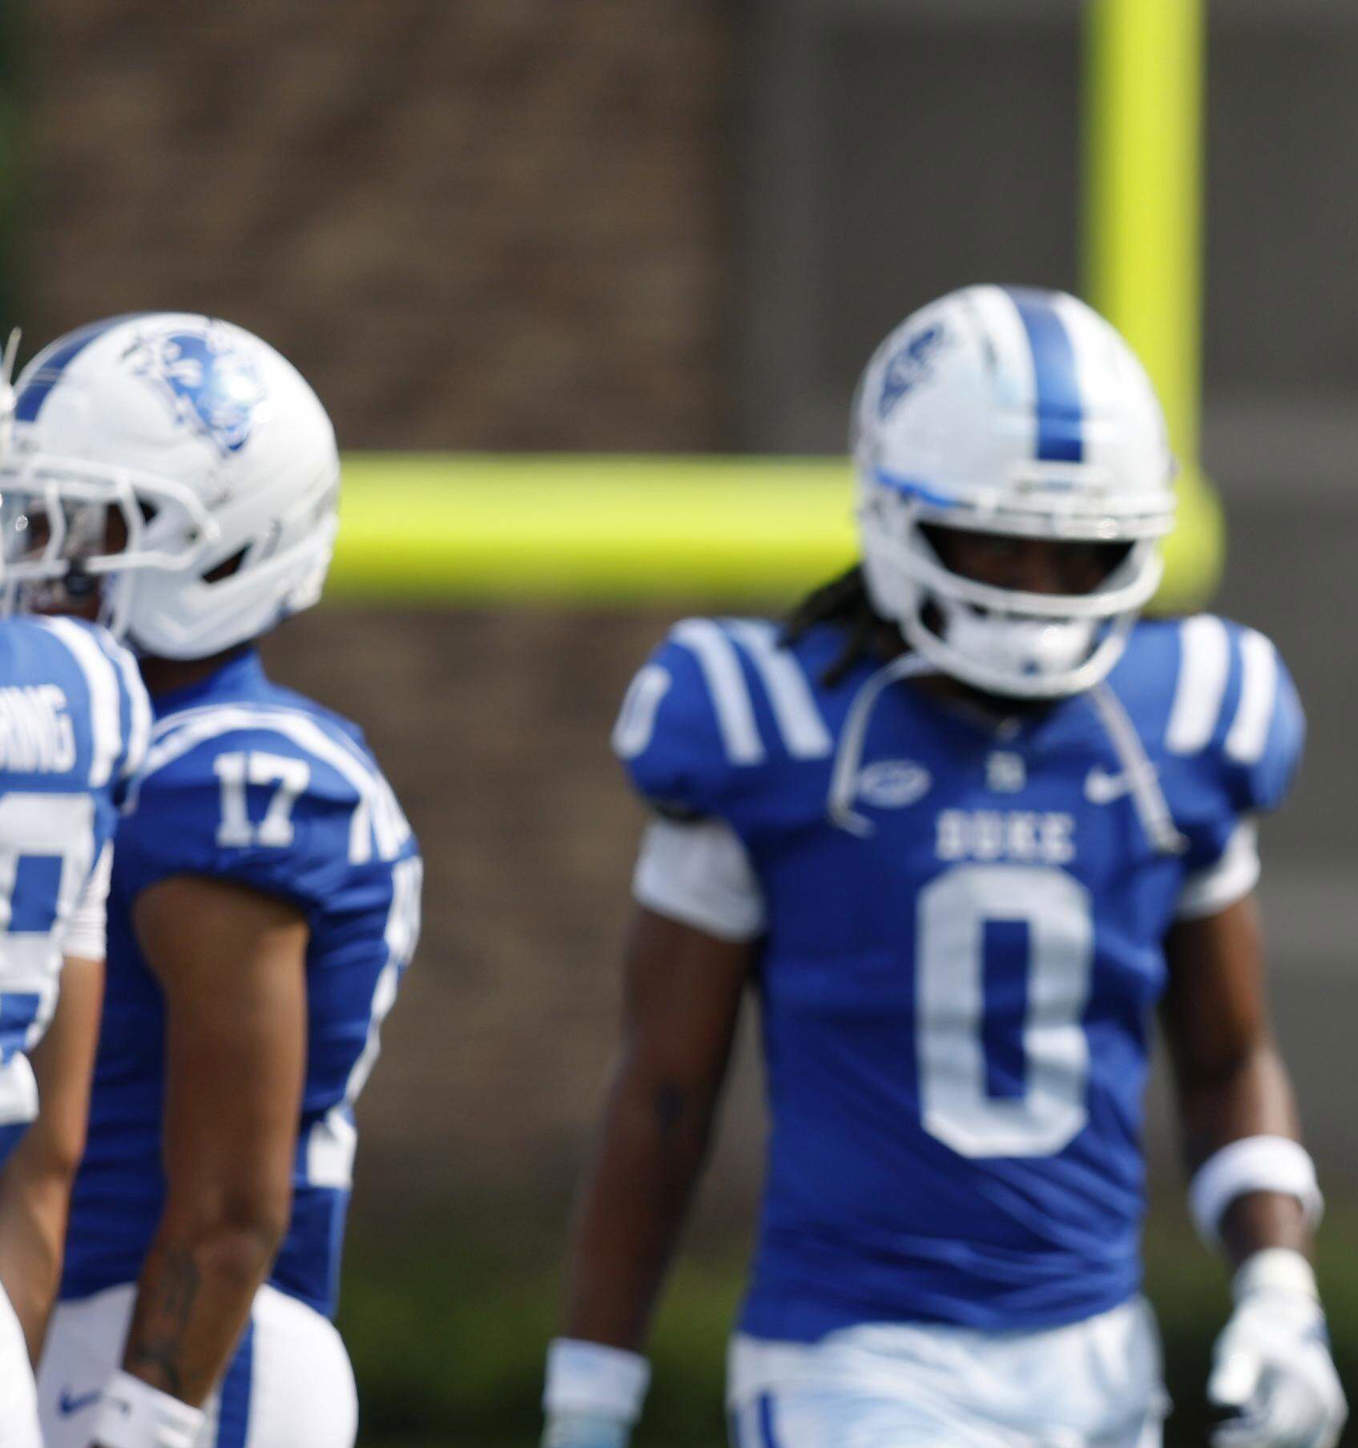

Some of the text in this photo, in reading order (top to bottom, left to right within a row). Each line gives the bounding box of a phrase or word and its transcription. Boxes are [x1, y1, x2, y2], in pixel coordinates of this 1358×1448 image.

[213, 750, 311, 848] 17
[935, 809, 1077, 864] DUKE
[915, 862, 1094, 1160] 0
